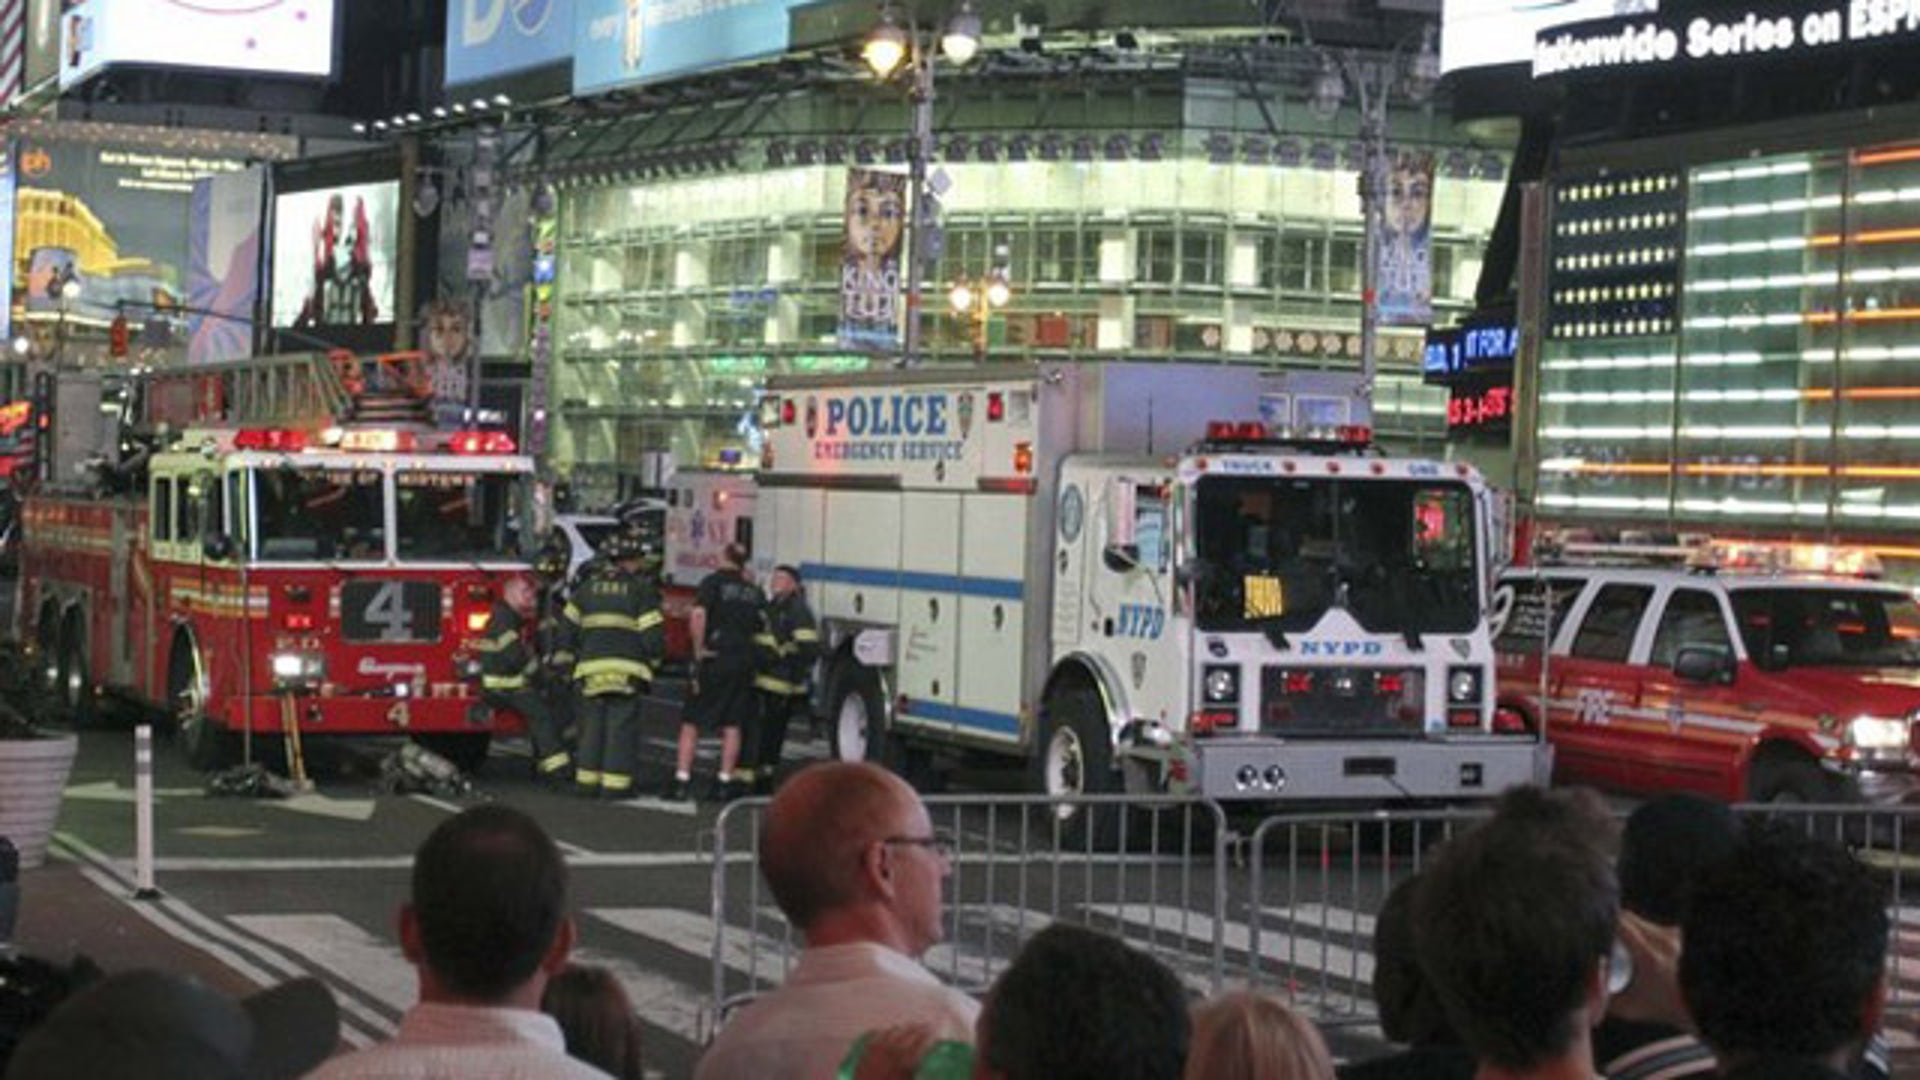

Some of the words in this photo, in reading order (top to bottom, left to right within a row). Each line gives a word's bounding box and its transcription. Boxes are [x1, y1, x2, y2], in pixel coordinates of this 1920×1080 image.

[1686, 13, 1795, 58] Series
[1802, 10, 1841, 45] on
[843, 261, 898, 292] KING
[826, 395, 949, 437] POLICE
[815, 441, 895, 461] EMERGENCY
[901, 441, 964, 461] SERVICE
[364, 576, 413, 642] 4
[1116, 602, 1166, 640] NYPD
[1301, 640, 1383, 656] NYPD
[386, 701, 411, 728] 4
